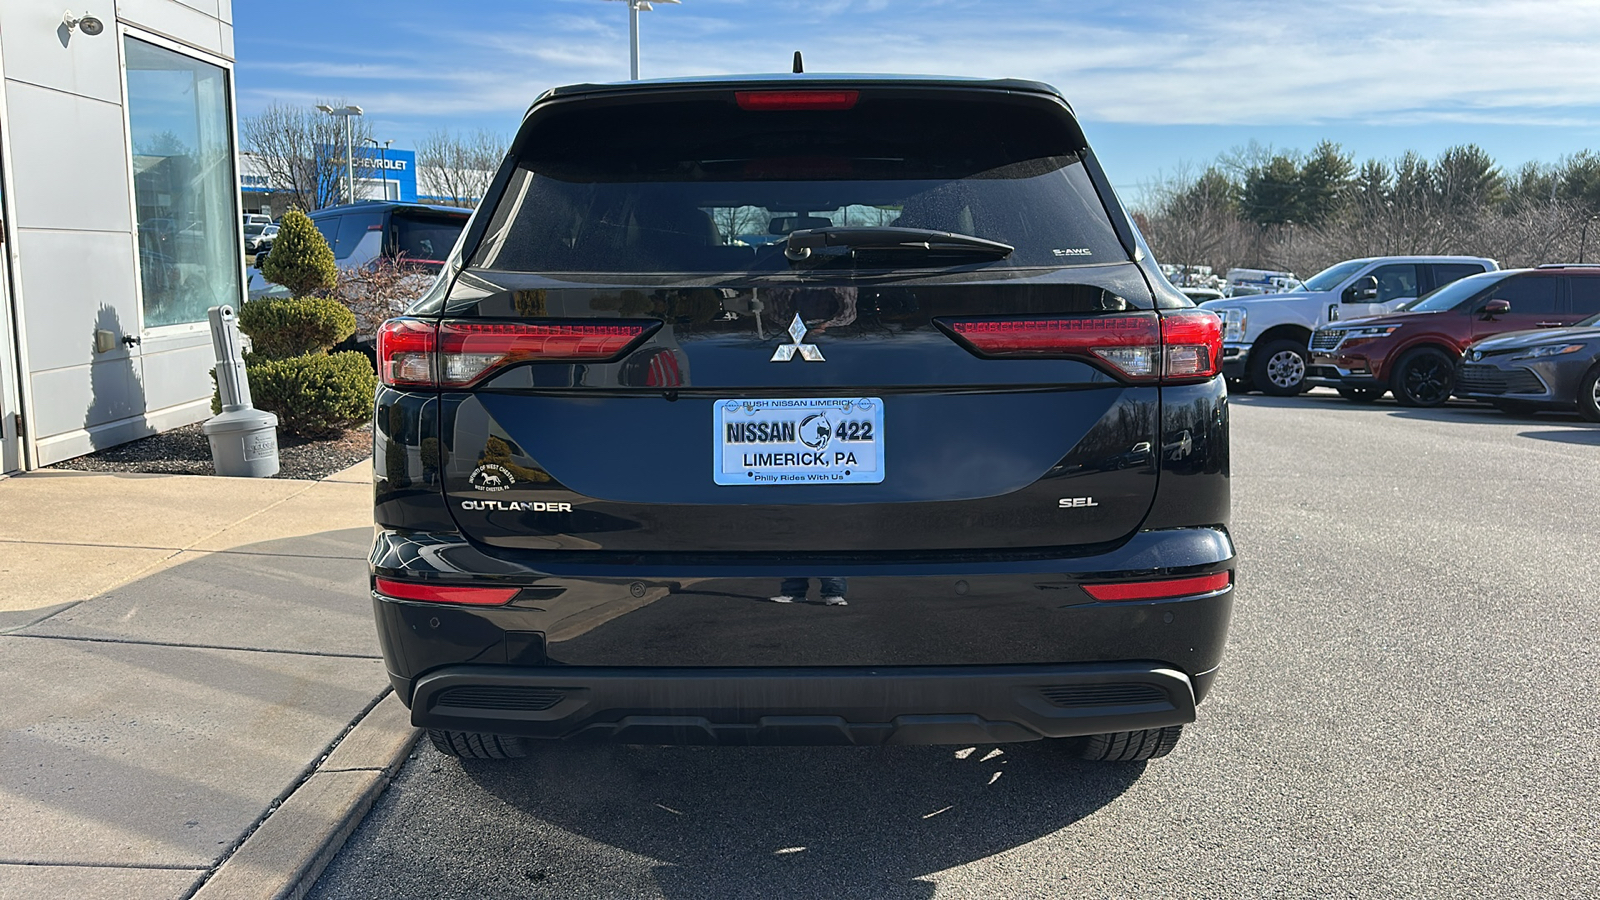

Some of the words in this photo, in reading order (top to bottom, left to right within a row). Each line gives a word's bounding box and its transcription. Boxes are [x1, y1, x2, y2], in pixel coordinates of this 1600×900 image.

[352, 157, 407, 170] CHEVROLET
[1052, 248, 1092, 256] S-AWC
[726, 422, 796, 444] NISSAN
[835, 418, 874, 442] 422
[743, 452, 830, 468] LIMERICK,
[834, 452, 858, 466] PA
[486, 463, 500, 471] WEST
[499, 466, 516, 485] CHESTER
[754, 475, 779, 483] Philly
[780, 474, 806, 482] Rides
[807, 473, 830, 482] With
[831, 473, 844, 481] Us
[461, 500, 573, 513] OUTLANDER
[1058, 496, 1099, 508] SEL
